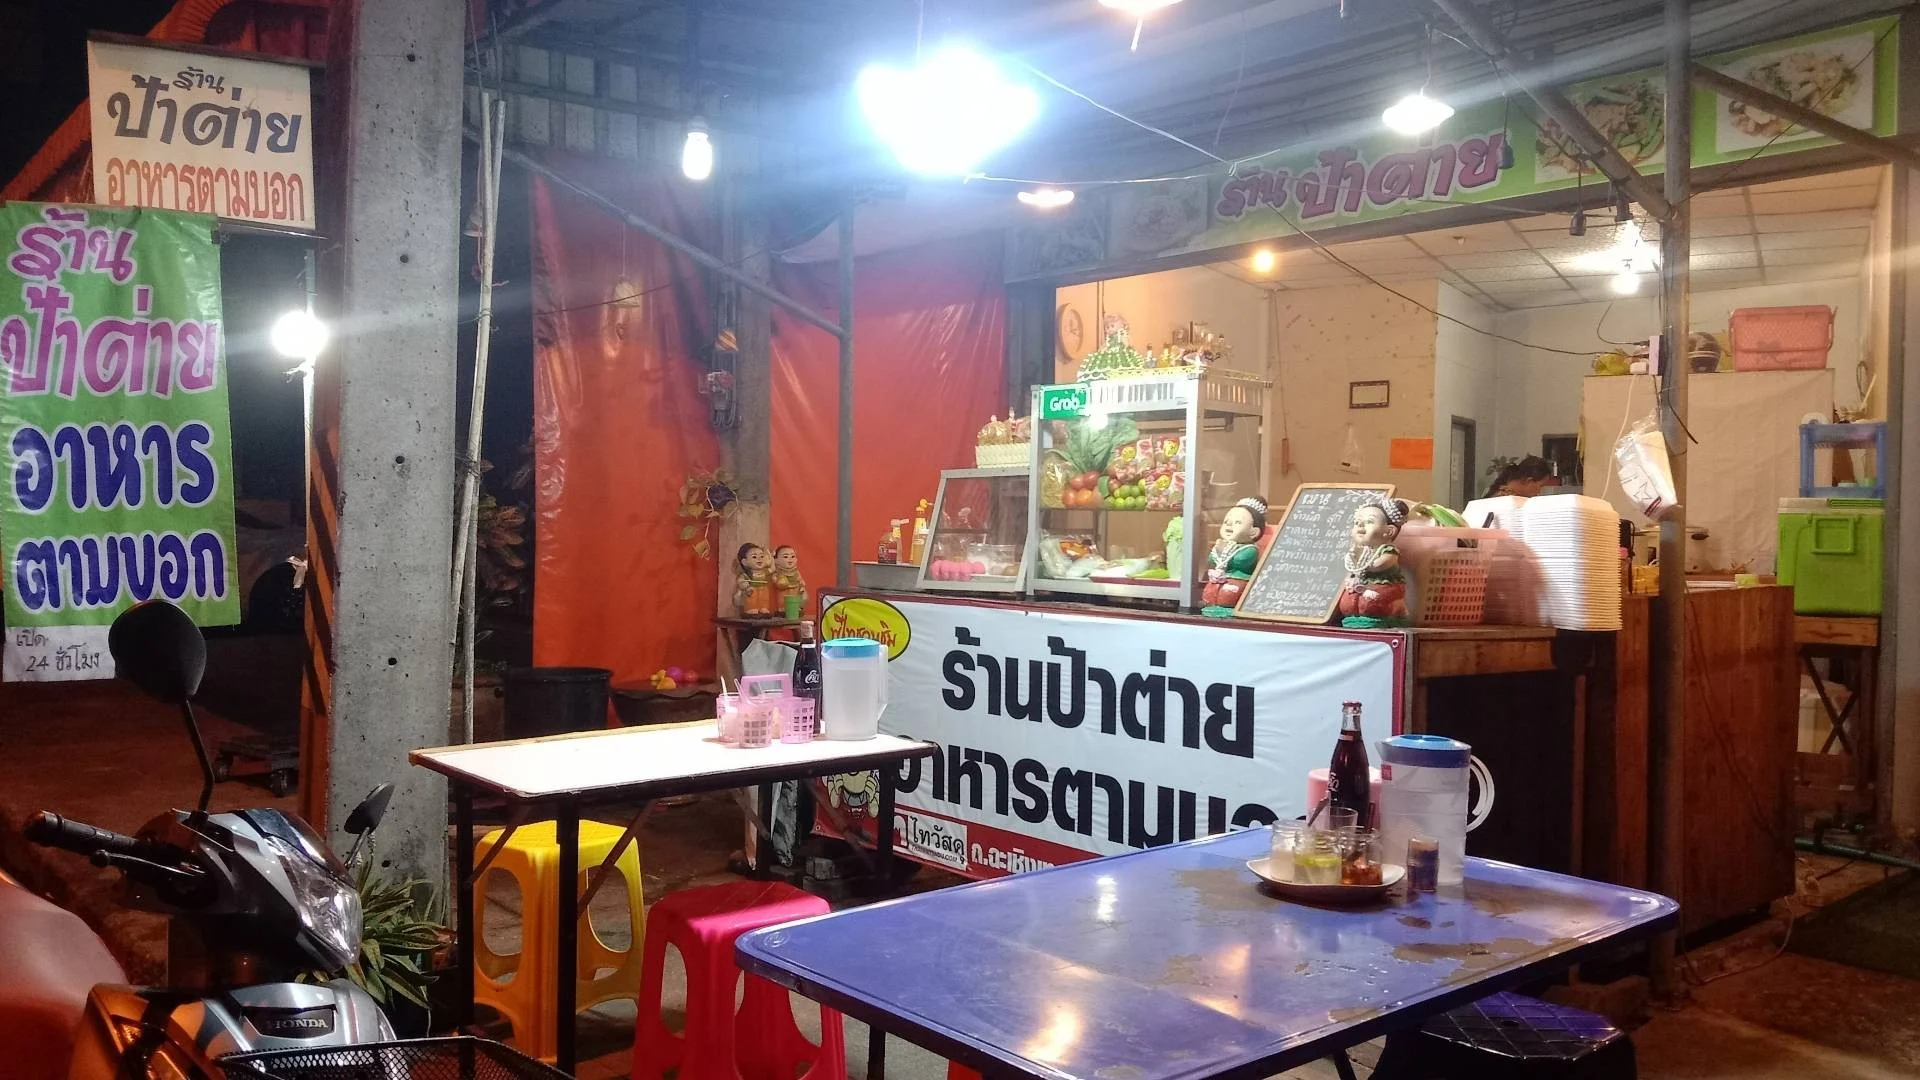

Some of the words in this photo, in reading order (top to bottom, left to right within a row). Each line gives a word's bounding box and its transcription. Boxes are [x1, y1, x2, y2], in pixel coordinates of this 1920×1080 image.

[172, 66, 225, 95] ร้าน
[106, 157, 305, 222] อาหารตามบอก
[10, 207, 135, 283] ร้าน
[1050, 393, 1079, 412] Grab
[12, 422, 216, 510] อาหาร
[16, 532, 225, 610] ตามบอก
[16, 628, 46, 647] เปิด
[25, 655, 49, 672] 24
[56, 642, 100, 671] ชั่วโมง
[942, 626, 1255, 759] ร้านป้าต่าย
[910, 815, 965, 865] ไทวัสดุ
[268, 1018, 328, 1029] HONDA
